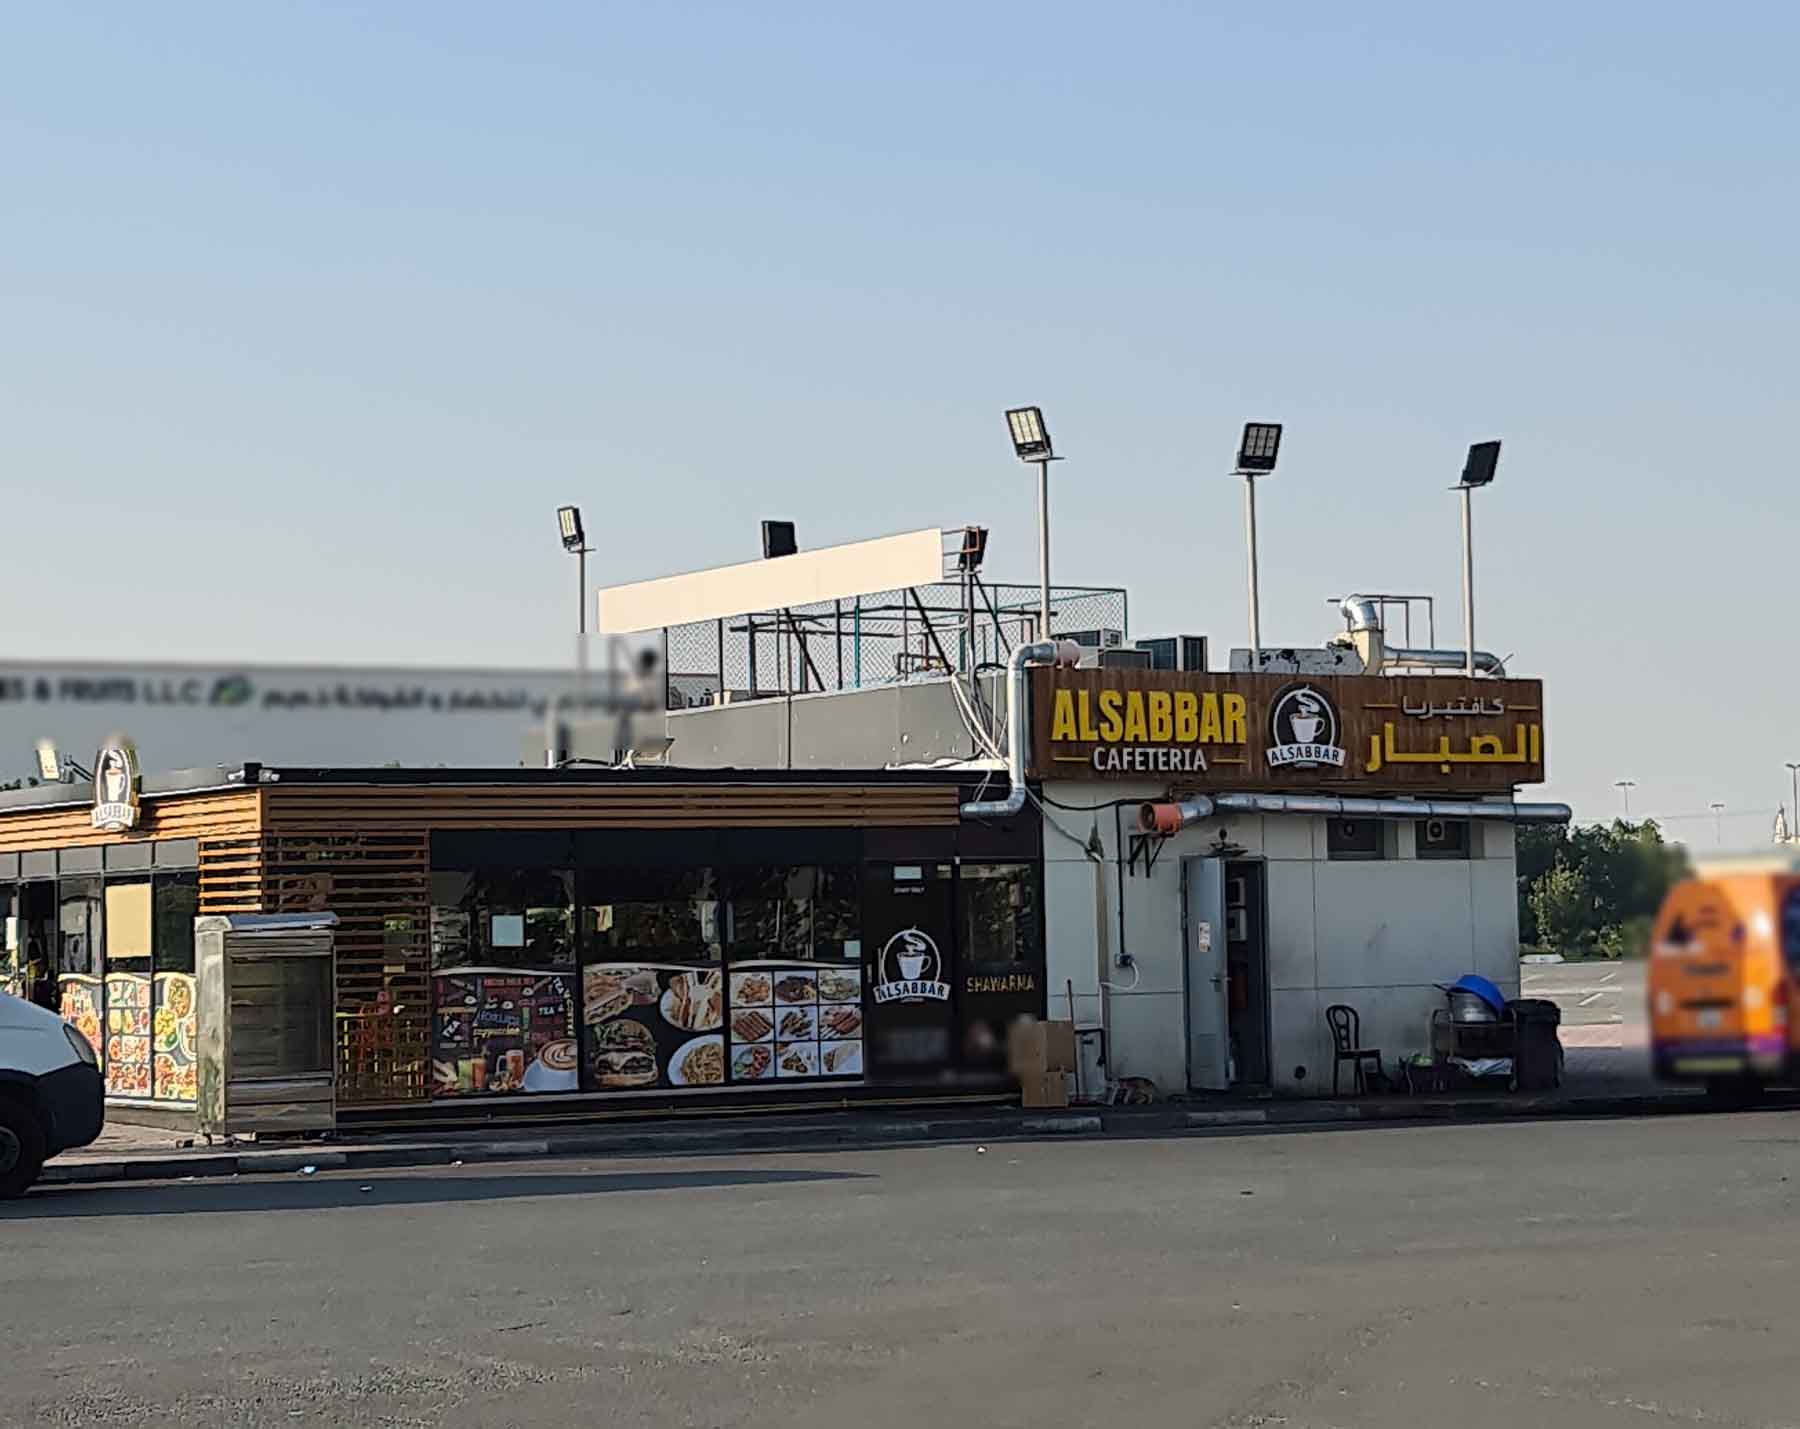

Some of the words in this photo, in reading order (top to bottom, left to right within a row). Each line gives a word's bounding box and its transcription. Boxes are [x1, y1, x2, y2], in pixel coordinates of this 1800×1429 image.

[1051, 689, 1247, 744] ALSABBAR
[1402, 695, 1505, 720] كافتيريا
[1093, 746, 1208, 772] CAFETERIA
[1271, 746, 1339, 763] ALSABBAR
[1366, 721, 1540, 774] الصبار
[876, 982, 945, 999] ALSABBAR
[966, 975, 1035, 993] SHAWARMA
